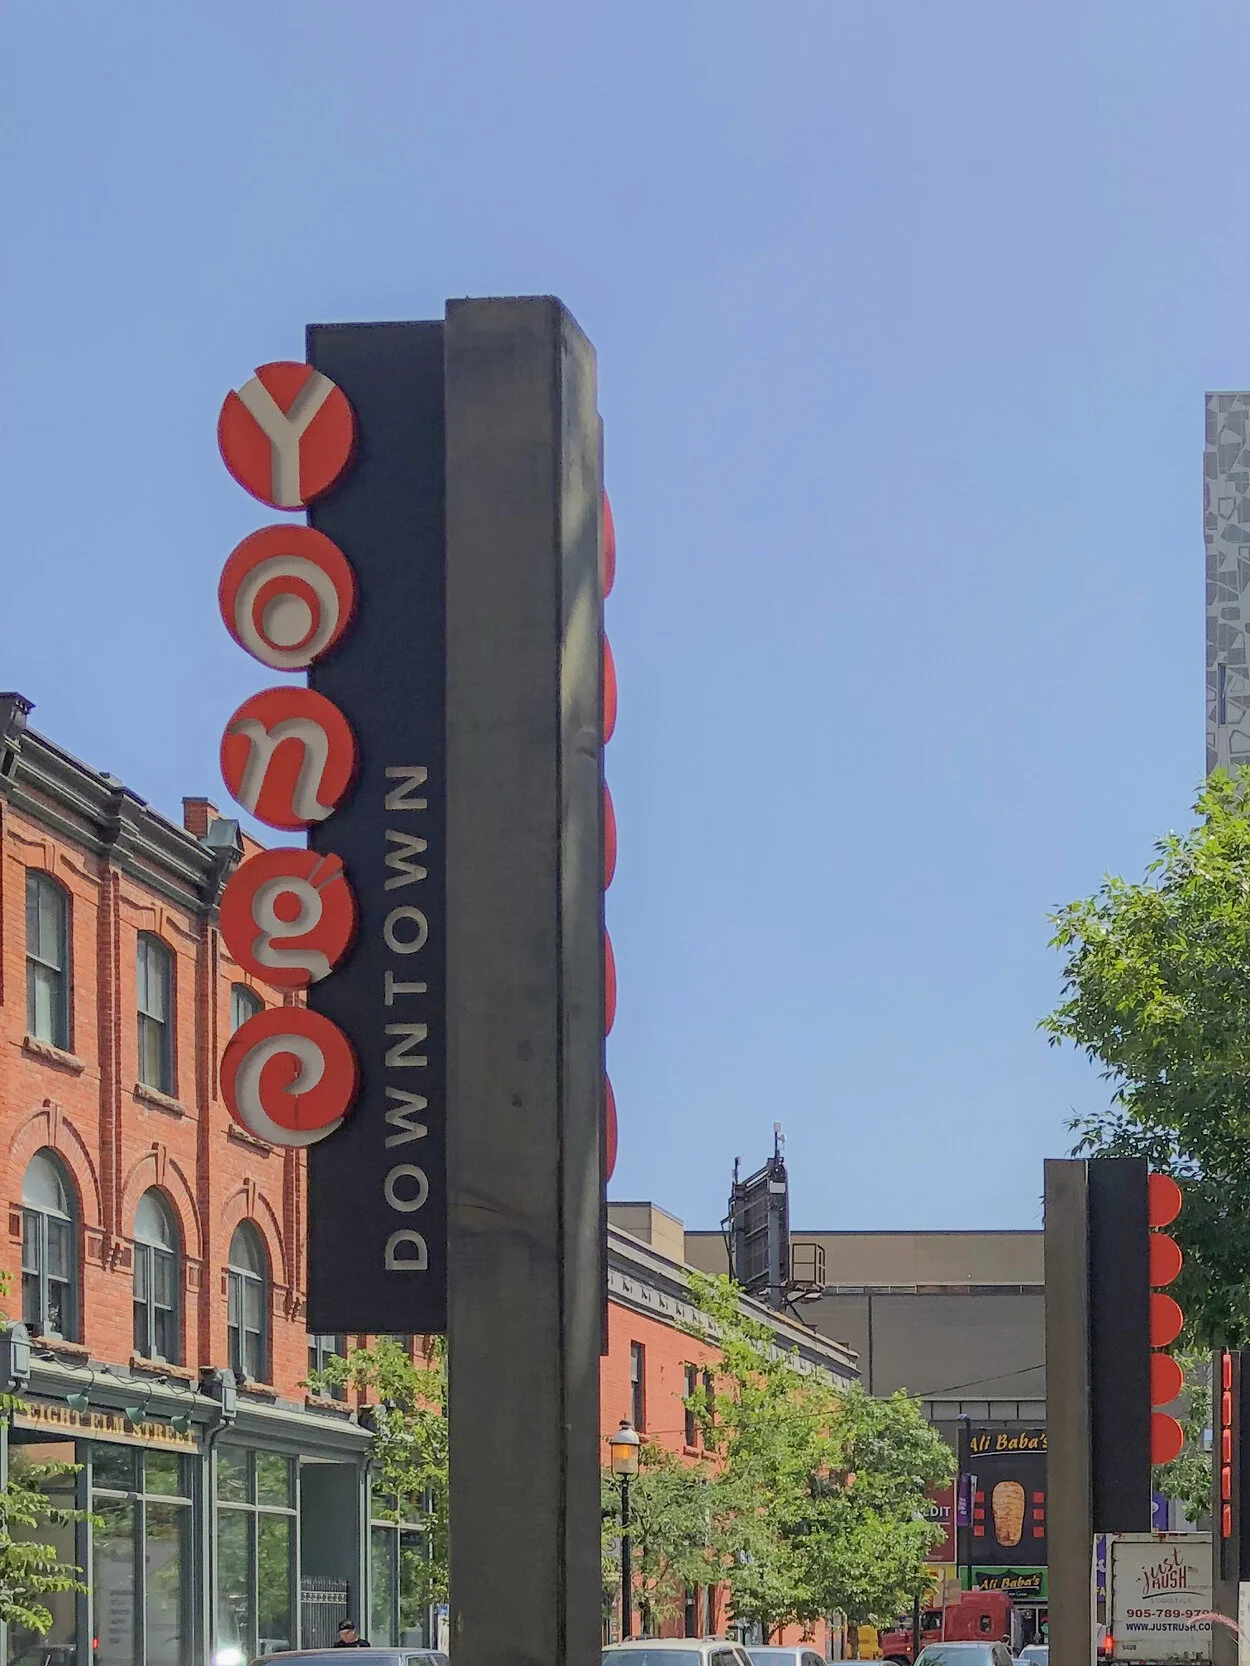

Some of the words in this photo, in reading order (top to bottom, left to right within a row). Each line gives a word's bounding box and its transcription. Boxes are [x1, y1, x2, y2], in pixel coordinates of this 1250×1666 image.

[228, 368, 344, 1148] Yonge
[385, 765, 428, 1273] DOWNTOWN
[26, 1403, 82, 1427] EIGHT
[90, 1412, 125, 1436] ELM
[132, 1421, 196, 1446] STREET
[970, 1434, 991, 1452] Ali
[980, 1579, 997, 1590] Ali
[1001, 1574, 1041, 1589] Baba's
[1142, 1547, 1184, 1595] just
[1151, 1566, 1188, 1589] RUSH
[1126, 1608, 1212, 1618] 905-789-97
[1126, 1623, 1212, 1631] WWW.JUSTRUSH.CO
